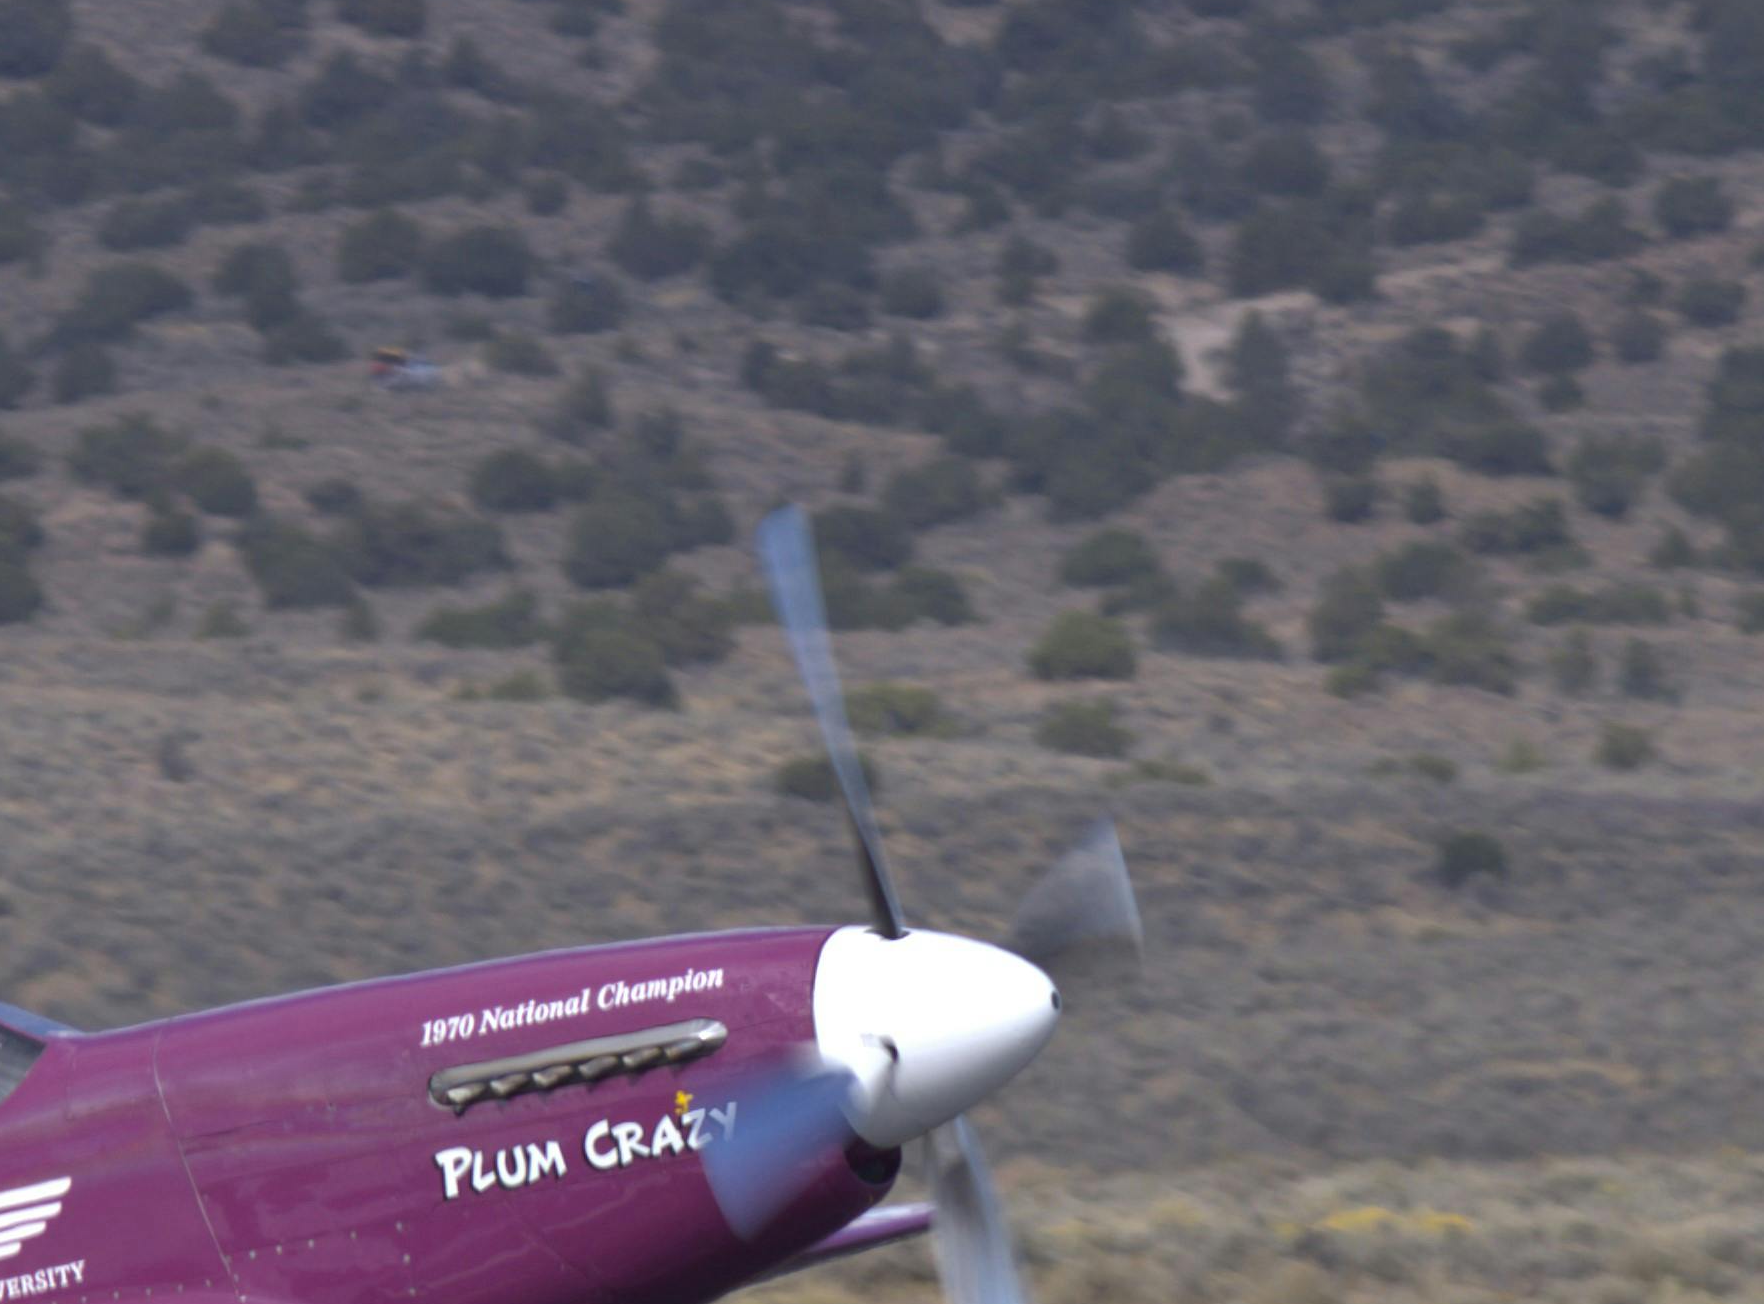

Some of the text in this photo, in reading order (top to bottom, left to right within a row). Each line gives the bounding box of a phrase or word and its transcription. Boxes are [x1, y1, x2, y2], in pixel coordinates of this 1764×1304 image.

[420, 967, 725, 1047] 1970 National Champion
[435, 1138, 567, 1199] PLUM
